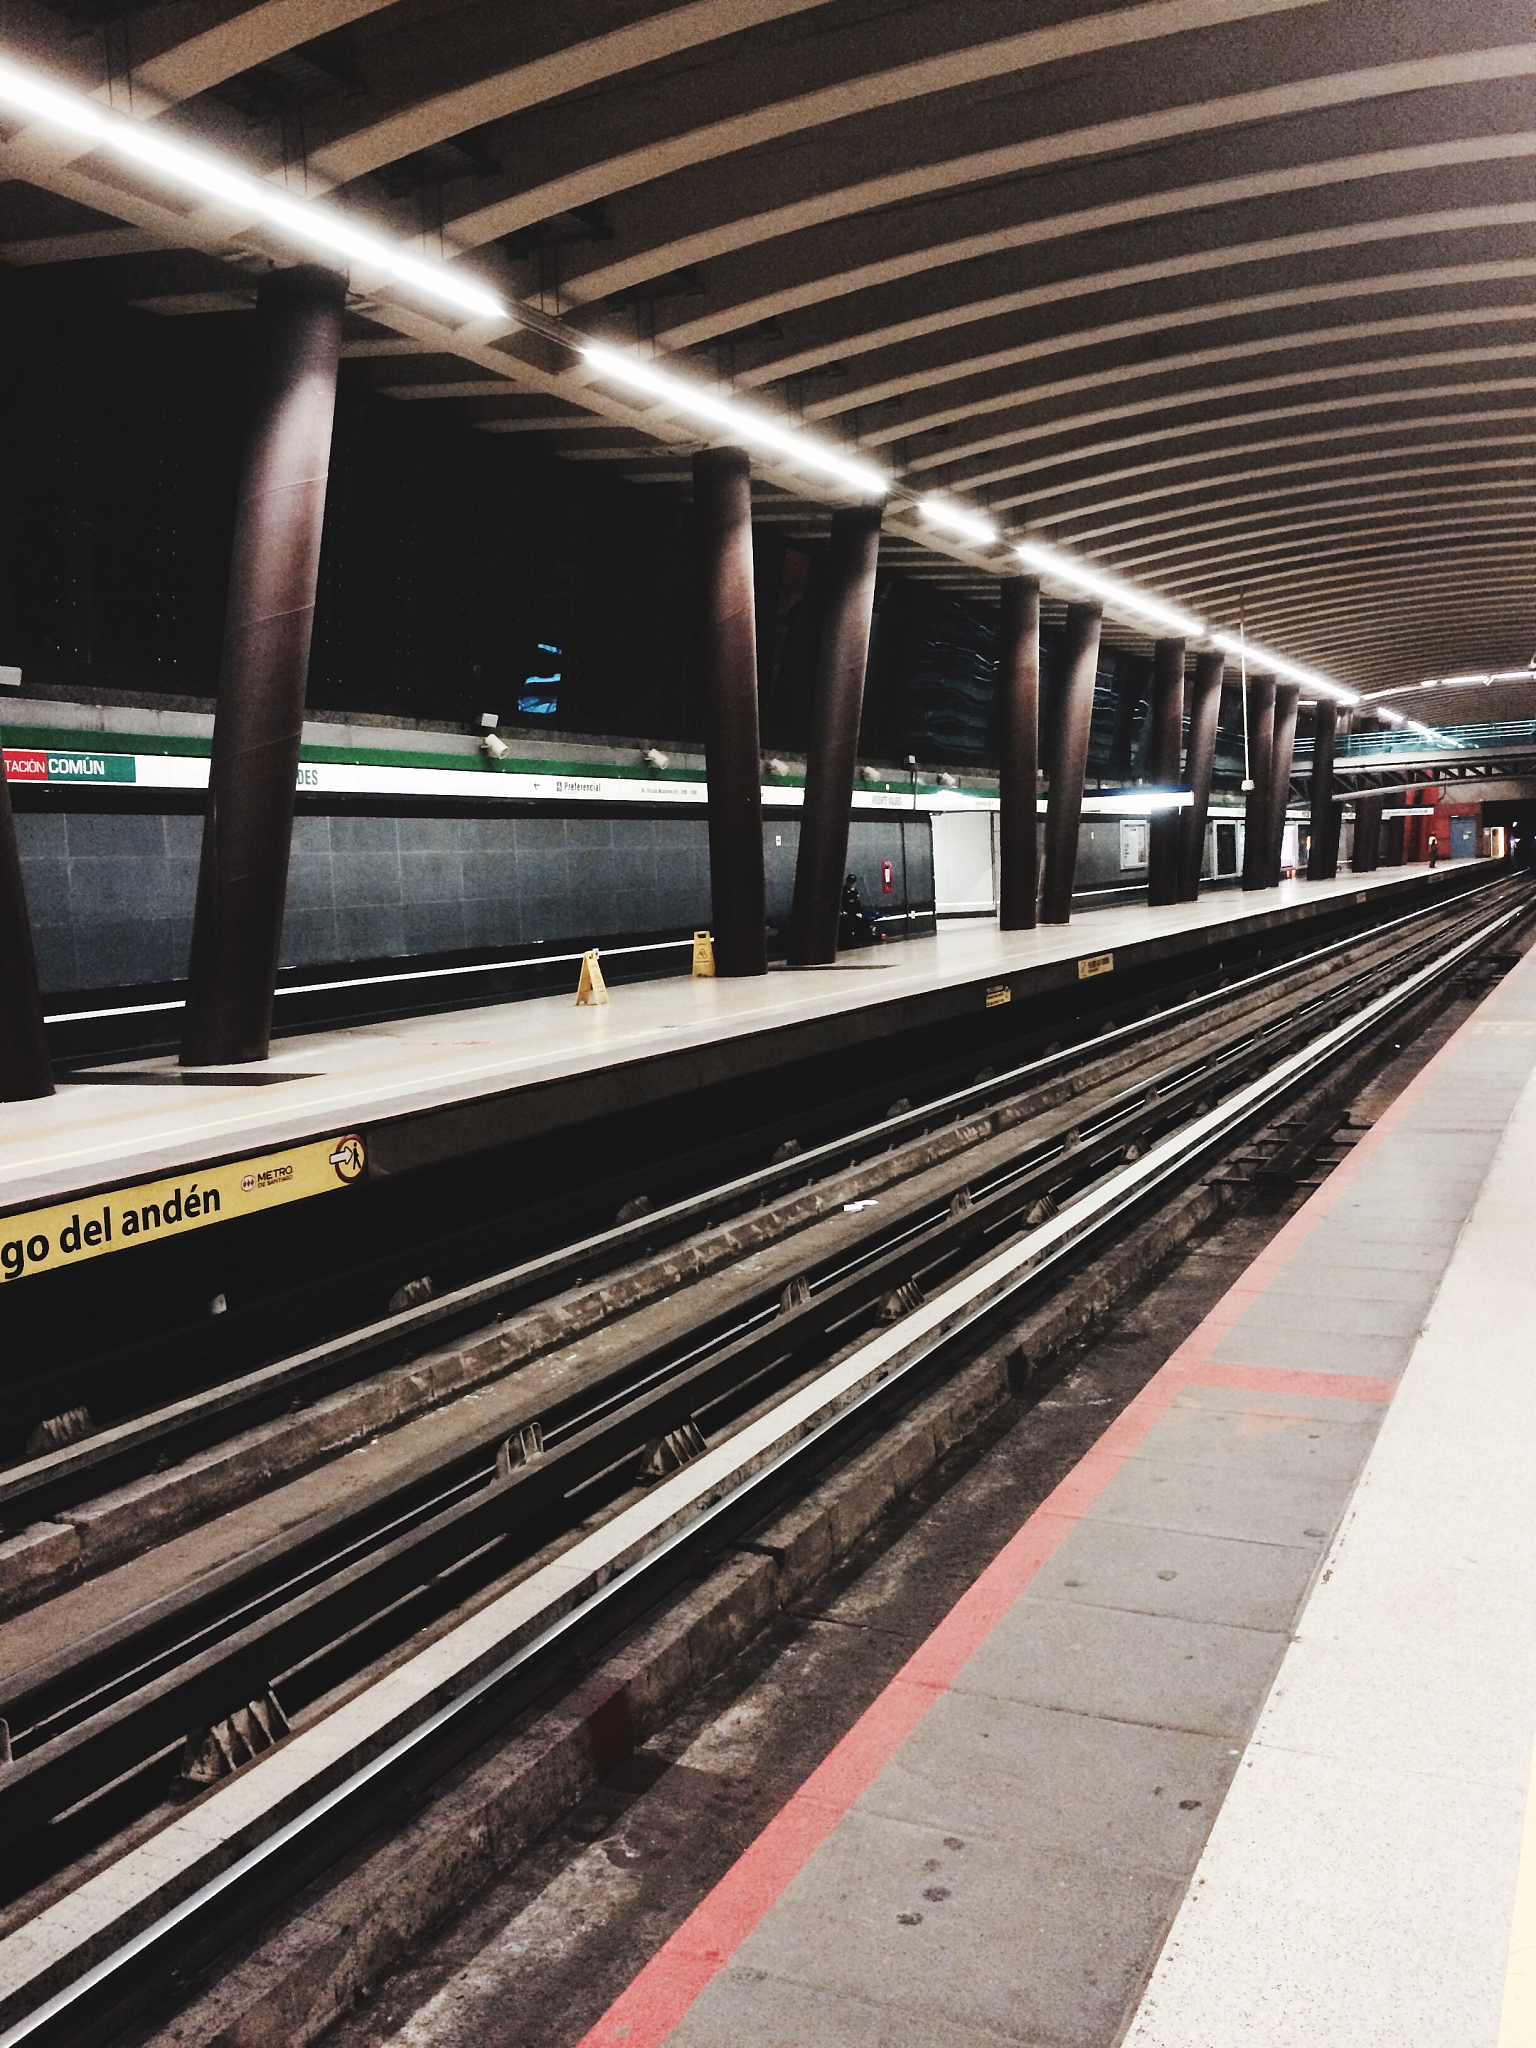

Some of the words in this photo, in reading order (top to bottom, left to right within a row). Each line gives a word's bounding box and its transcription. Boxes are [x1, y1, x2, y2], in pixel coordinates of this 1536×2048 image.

[48, 757, 105, 775] COMÚN
[564, 781, 601, 792] Preferencial
[257, 1165, 293, 1182] METRO
[267, 1175, 293, 1186] SANTIAGO
[59, 1206, 112, 1254] del
[121, 1184, 221, 1237] andén
